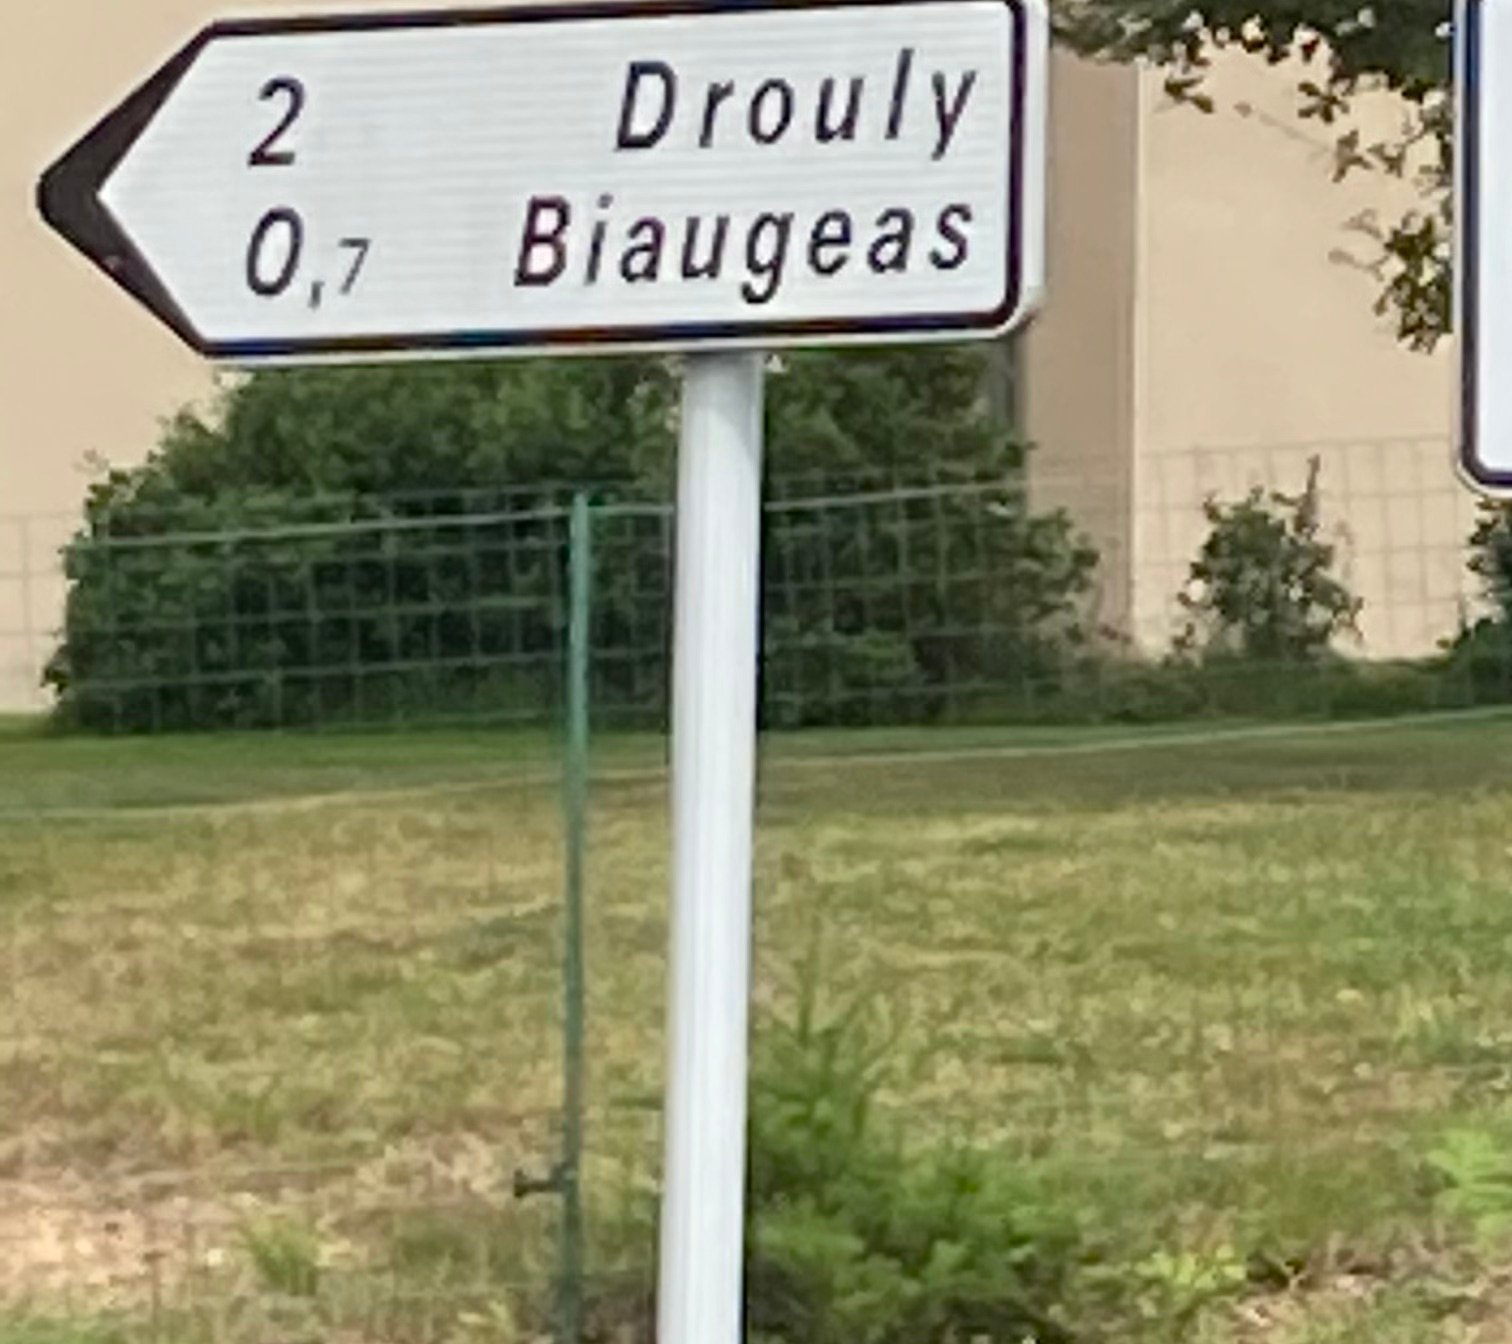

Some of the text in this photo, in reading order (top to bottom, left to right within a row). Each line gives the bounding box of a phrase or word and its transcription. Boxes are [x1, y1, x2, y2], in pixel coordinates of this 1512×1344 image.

[248, 48, 976, 167] 2 Drouly
[246, 195, 973, 308] 0,7 Biaugeas
